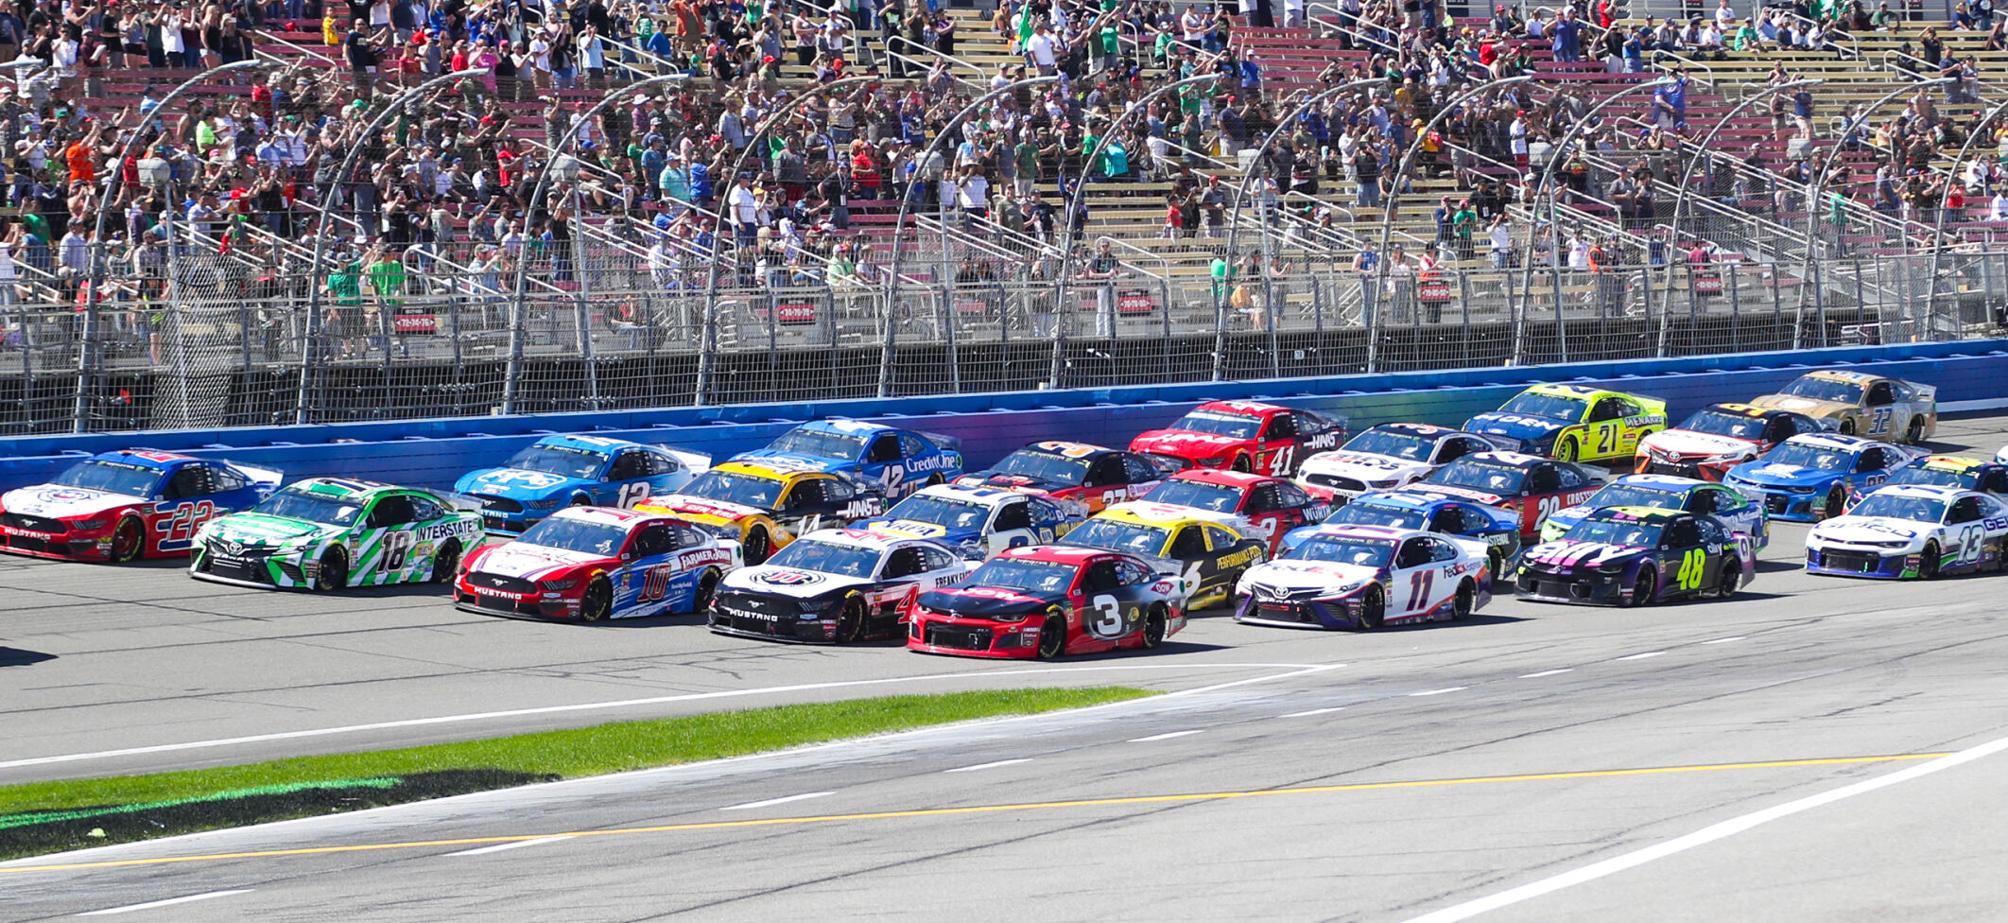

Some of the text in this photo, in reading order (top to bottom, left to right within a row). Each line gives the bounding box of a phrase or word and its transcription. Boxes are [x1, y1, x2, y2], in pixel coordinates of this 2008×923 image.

[1474, 414, 1562, 430] MOEN
[1625, 415, 1663, 429] MENARDS
[1868, 407, 1893, 436] 32
[1303, 431, 1340, 450] HAAS
[1598, 424, 1618, 454] 21
[1269, 445, 1296, 477] 41
[617, 481, 651, 510] 12
[880, 464, 905, 499] 42
[167, 500, 215, 543] 22
[836, 497, 879, 519] HAAS
[1533, 495, 1560, 531] 20
[4, 526, 52, 541] MUSTANG
[416, 520, 473, 542] INTERSTATE
[797, 513, 822, 539] 14
[885, 518, 937, 537] NAPA
[376, 530, 412, 574] 18
[680, 547, 732, 569] FARMER JOHN
[1956, 524, 1986, 566] 13
[637, 562, 672, 603] 10
[935, 574, 960, 589] FREAKY
[1179, 560, 1205, 601] 6
[1442, 562, 1467, 580] FedEx
[1676, 547, 1707, 590] 48
[474, 586, 523, 601] MUSTANG
[895, 582, 920, 625] 4
[1407, 569, 1435, 612] 11
[728, 608, 779, 623] MUSTANG
[1093, 593, 1122, 637] 3
